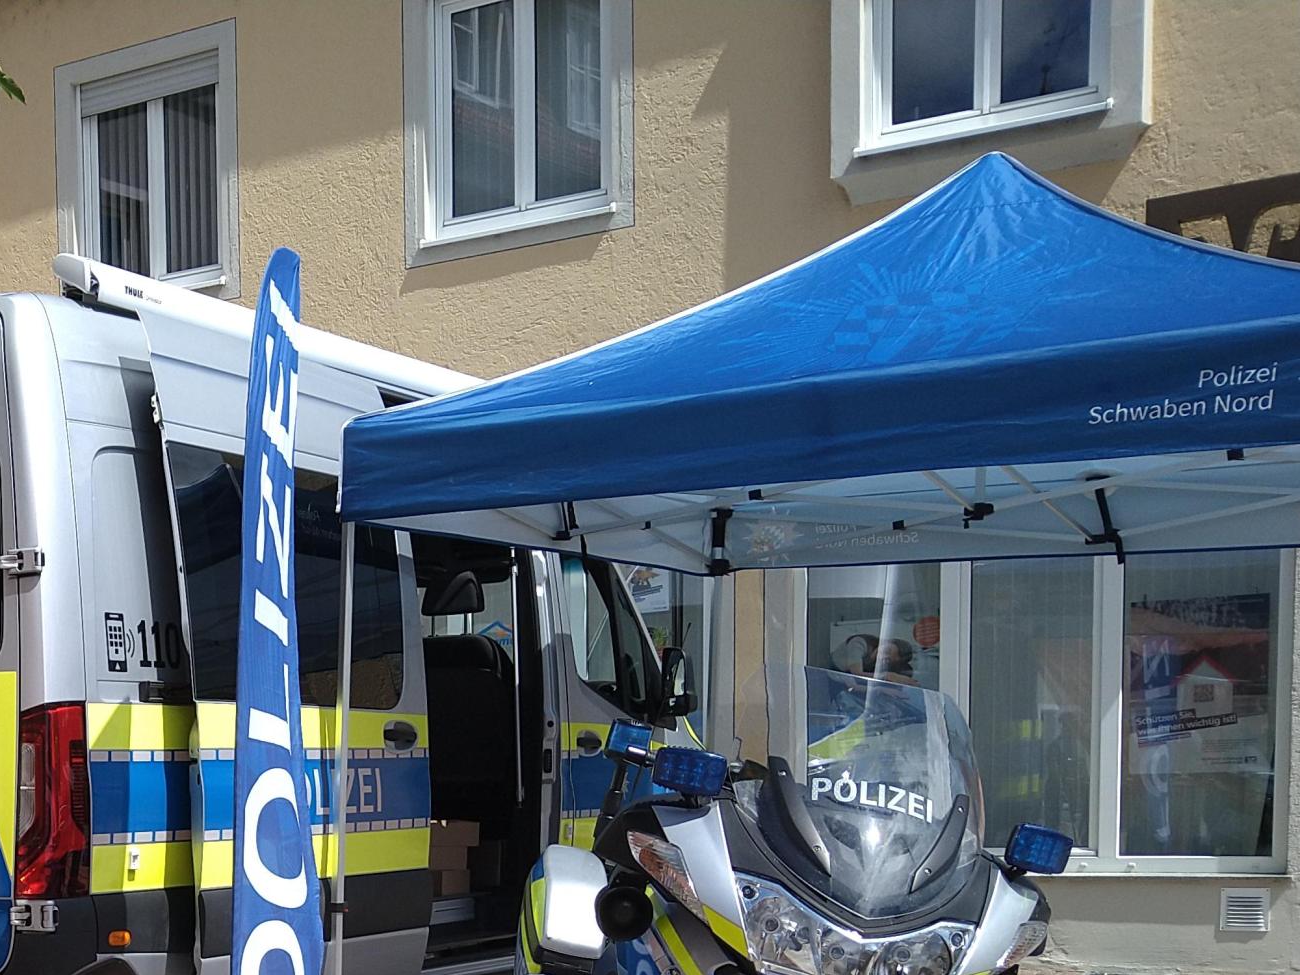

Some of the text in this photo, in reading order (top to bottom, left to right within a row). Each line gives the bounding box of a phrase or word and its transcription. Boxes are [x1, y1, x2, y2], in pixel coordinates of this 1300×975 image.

[124, 285, 143, 299] THULE
[1198, 362, 1278, 388] Polizei
[1088, 389, 1274, 425] Schwaben Nord
[137, 619, 180, 669] 110
[1187, 717, 1221, 730] wichtig
[305, 768, 382, 816] LZEI
[811, 777, 933, 824] POLIZEI
